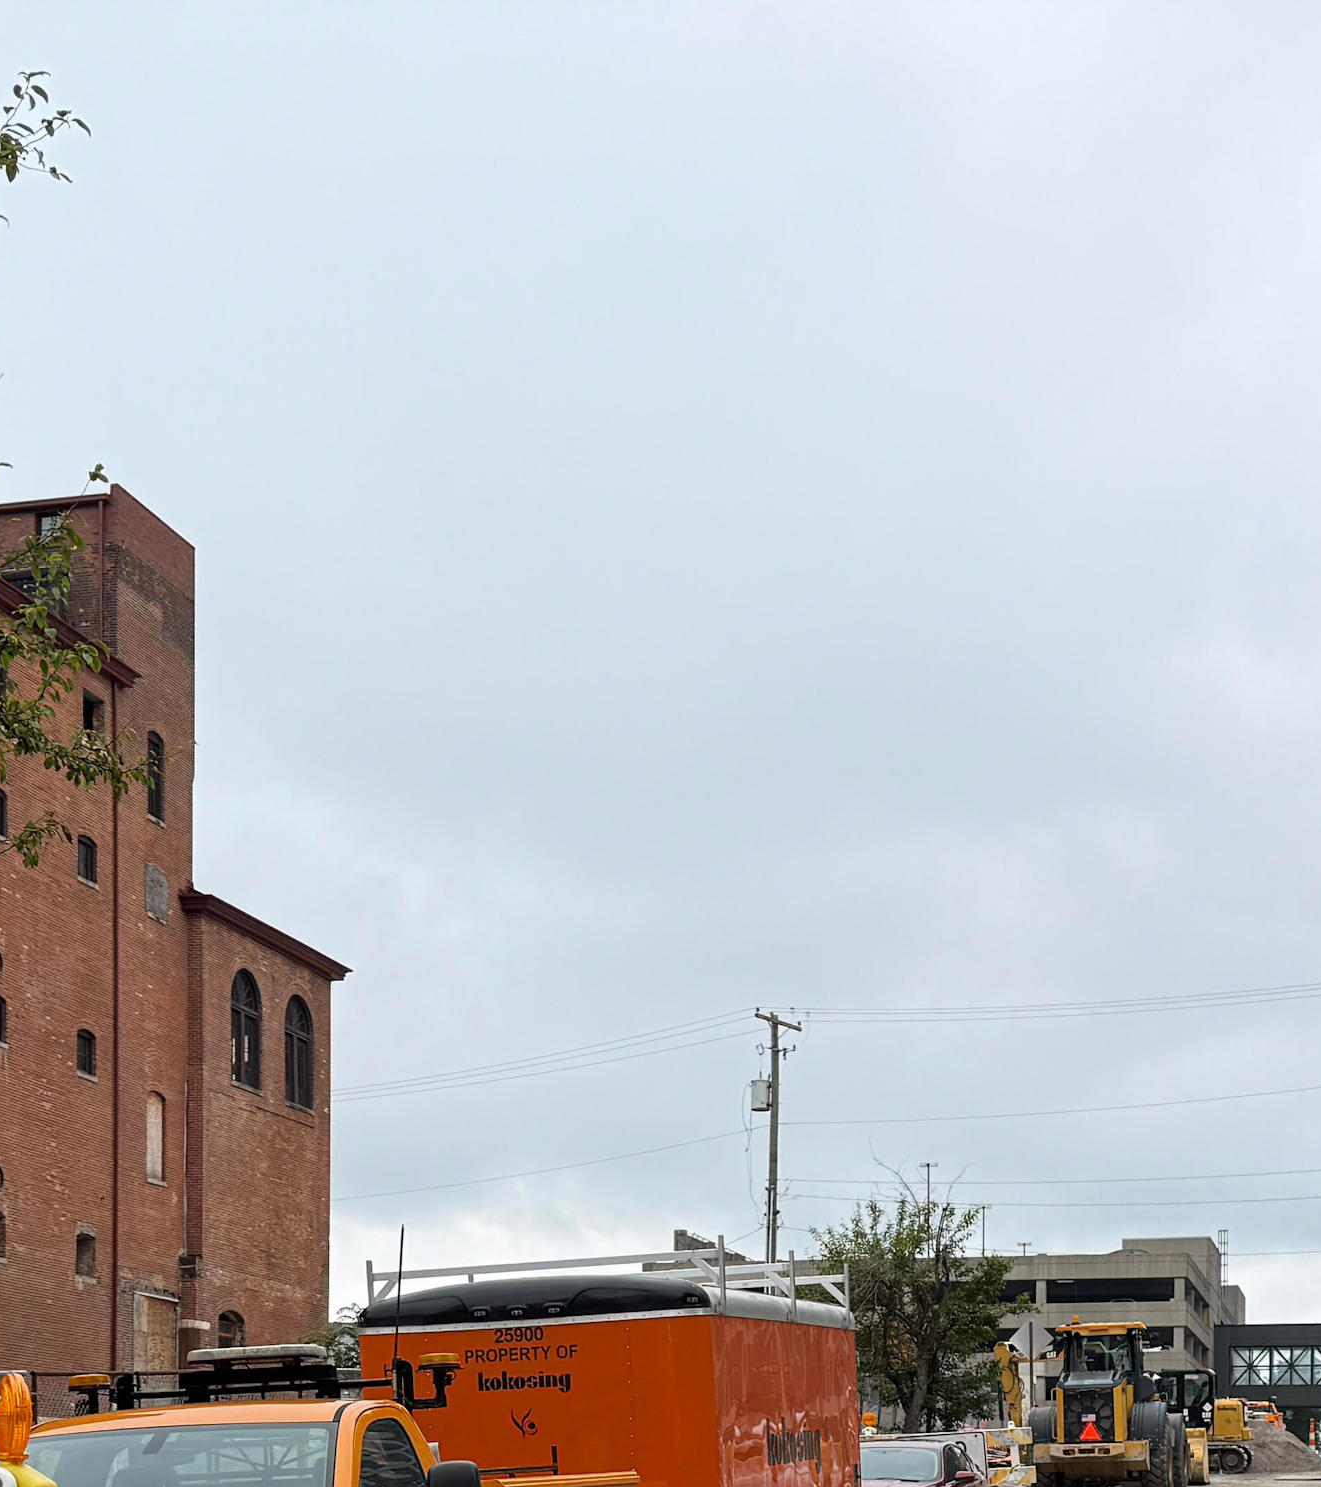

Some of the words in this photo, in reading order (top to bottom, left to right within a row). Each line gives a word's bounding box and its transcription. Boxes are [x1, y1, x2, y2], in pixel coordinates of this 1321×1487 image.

[494, 1326, 544, 1343] 25900
[464, 1346, 551, 1364] PROPERTY
[556, 1344, 578, 1359] OF
[478, 1371, 571, 1393] kokosing
[766, 1417, 821, 1474] kokosing
